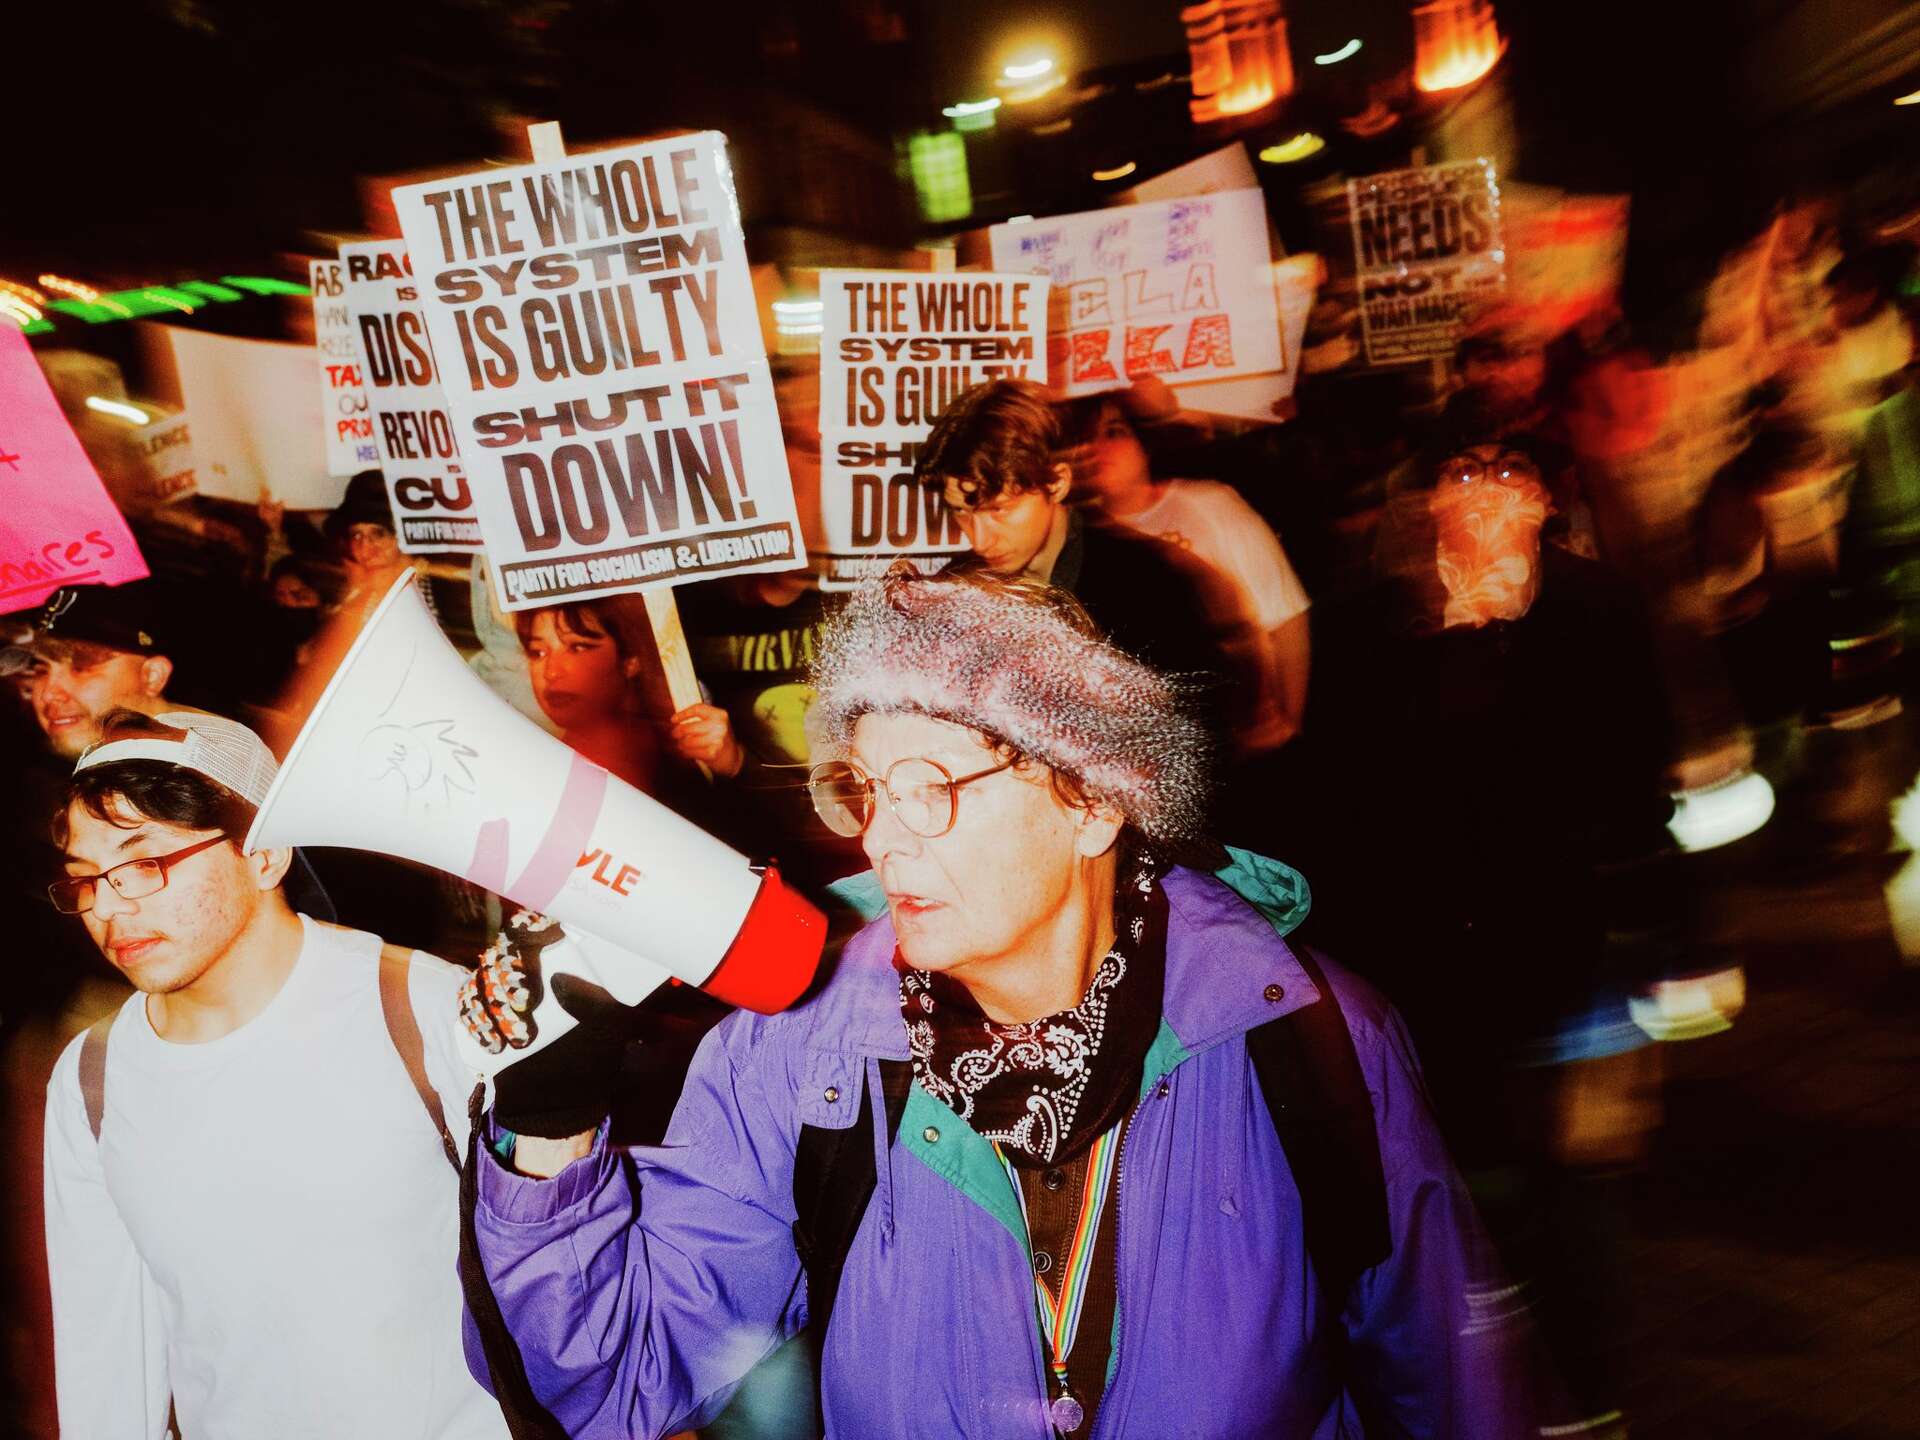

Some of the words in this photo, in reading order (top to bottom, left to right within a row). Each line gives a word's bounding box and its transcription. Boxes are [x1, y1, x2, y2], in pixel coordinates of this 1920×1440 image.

[424, 180, 524, 264] THE
[523, 147, 709, 248] WHOLE
[1359, 195, 1489, 267] NEEDS
[396, 286, 418, 301] IS
[435, 227, 723, 305] SYSTEM
[1364, 267, 1462, 298] NOT
[454, 305, 519, 391] IS
[520, 269, 724, 381] GUILTY
[843, 282, 908, 333] THE
[915, 281, 1030, 333] WHOLE
[358, 310, 440, 387] DIS
[839, 337, 1034, 363] SYSTEM
[472, 384, 670, 449] SHUT
[683, 372, 751, 417] IT
[847, 366, 885, 427] IS
[380, 410, 461, 459] REVO
[502, 419, 757, 553] DOWN!
[505, 566, 557, 597] PARTY
[557, 562, 590, 588] FOR
[589, 547, 676, 583] SOCIALISM
[676, 545, 699, 569] &
[698, 530, 790, 565] LIBERATION
